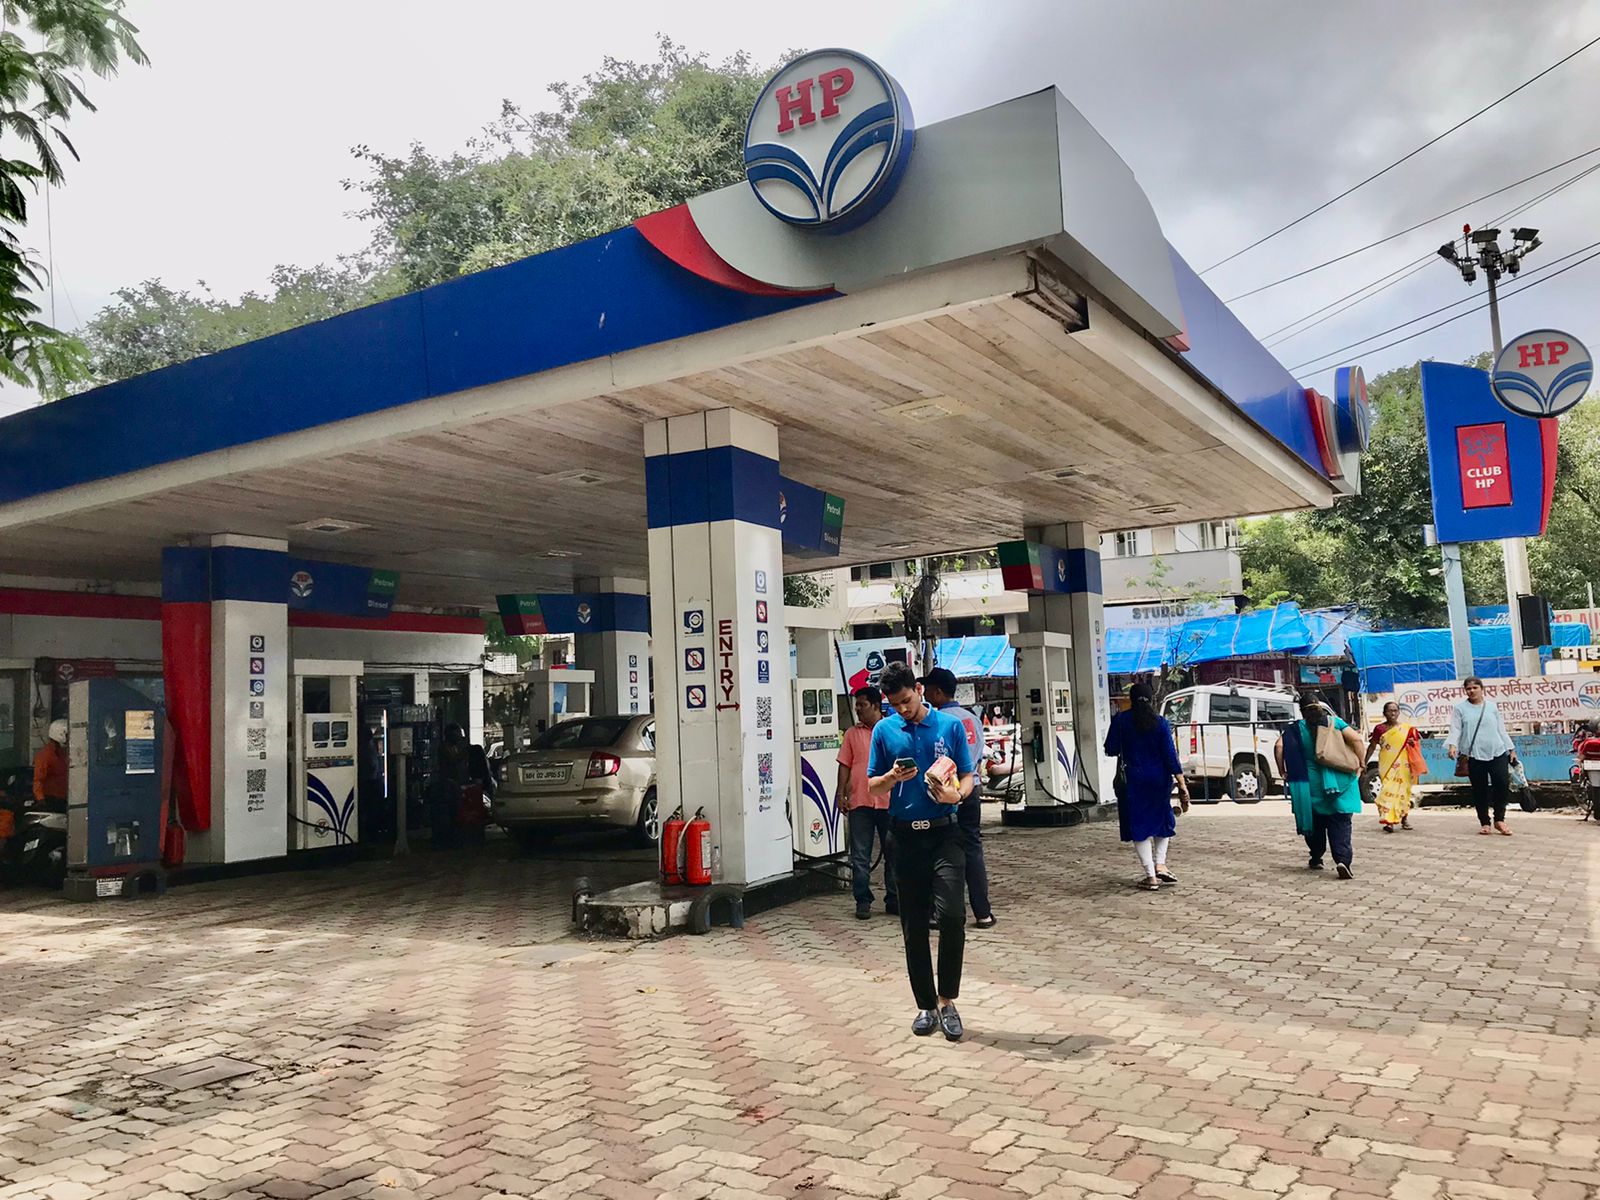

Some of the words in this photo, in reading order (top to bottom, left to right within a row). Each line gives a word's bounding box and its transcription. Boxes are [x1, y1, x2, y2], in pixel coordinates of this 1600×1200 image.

[775, 68, 855, 133] HP
[1517, 341, 1569, 368] HP
[1467, 466, 1502, 478] CLUB
[1475, 478, 1496, 489] HP
[826, 503, 841, 516] Petrol
[367, 599, 389, 609] Diesel
[718, 619, 735, 702] ENTRY
[1500, 679, 1533, 697] सर्विस
[1535, 678, 1575, 695] स्टेशन
[1404, 694, 1421, 703] HP
[1496, 699, 1534, 712] ERVICE
[1537, 697, 1580, 710] STATION
